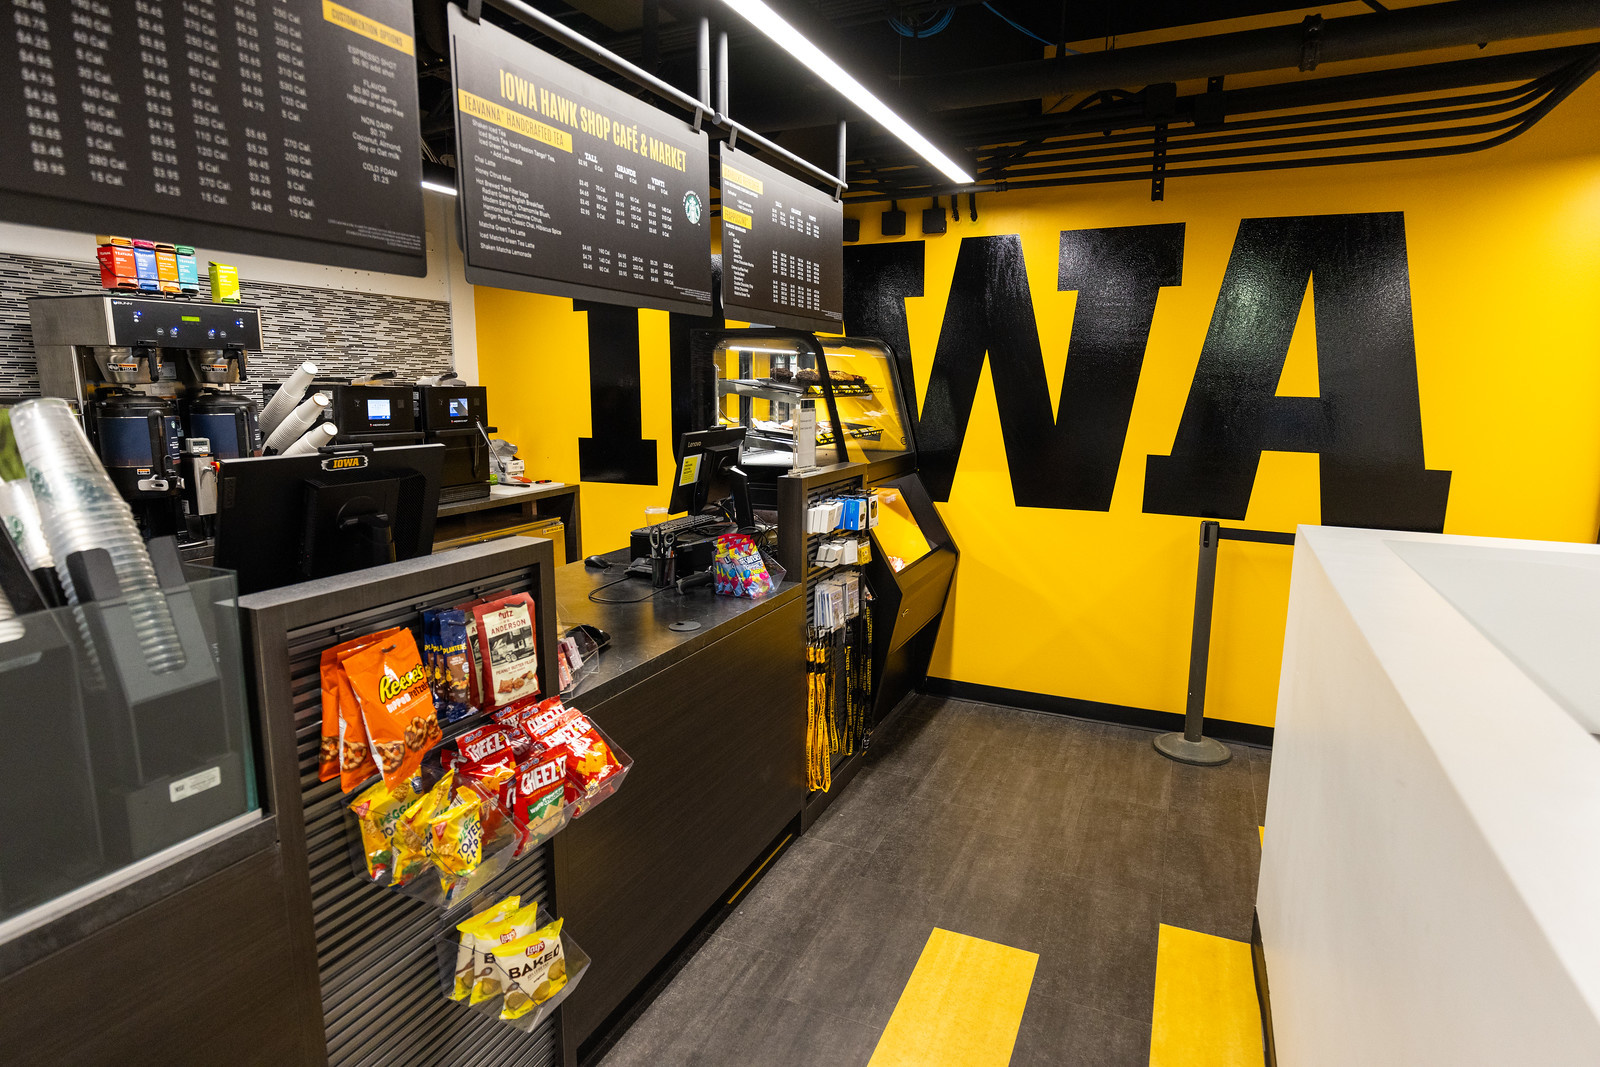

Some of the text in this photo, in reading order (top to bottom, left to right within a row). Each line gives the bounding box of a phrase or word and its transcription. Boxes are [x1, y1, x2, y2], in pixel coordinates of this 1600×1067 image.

[360, 115, 394, 131] NON DAIRY
[499, 68, 687, 173] IOWA HAWK SHOP CAFÉ & MARKET
[506, 113, 551, 143] HANDCRAFTED
[552, 131, 564, 147] TEA
[362, 161, 398, 178] COLD FOAM
[584, 152, 666, 188] TALL GRANDE VENTI
[572, 211, 1452, 534] IWA
[688, 441, 702, 449] Lenovo
[333, 457, 360, 469] IOWA
[491, 618, 527, 635] ANDERSON
[443, 643, 467, 655] PLANTERS
[508, 943, 560, 980] BAKED
